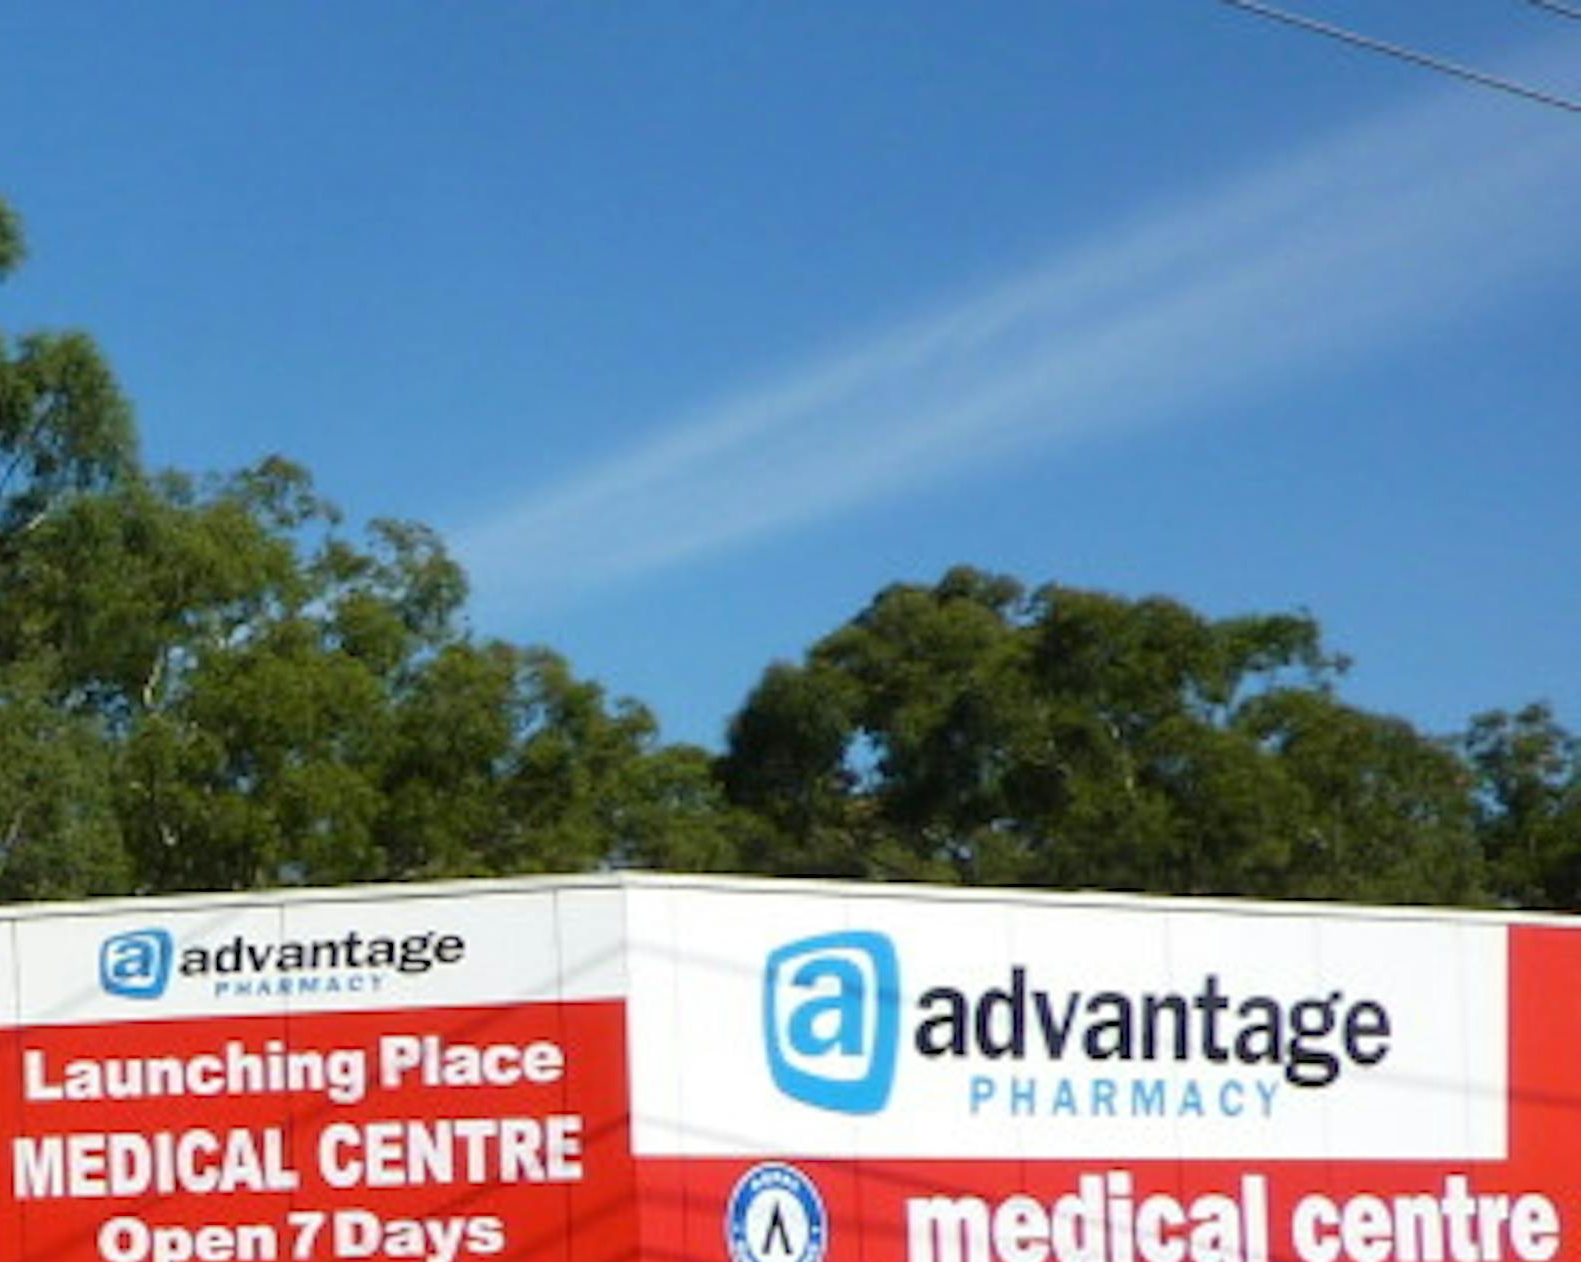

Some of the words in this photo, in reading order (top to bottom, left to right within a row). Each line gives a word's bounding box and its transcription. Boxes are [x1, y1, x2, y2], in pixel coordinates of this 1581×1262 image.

[180, 930, 466, 981] advantage
[214, 974, 384, 997] PHARMACY
[915, 966, 1392, 1087] advantage
[23, 1040, 366, 1105] Launching
[378, 1034, 566, 1088] Place
[970, 1076, 1281, 1118] PHARMACY
[11, 1126, 299, 1200] MEDICAL
[318, 1114, 583, 1188] CENTRE
[287, 1212, 327, 1260] 7
